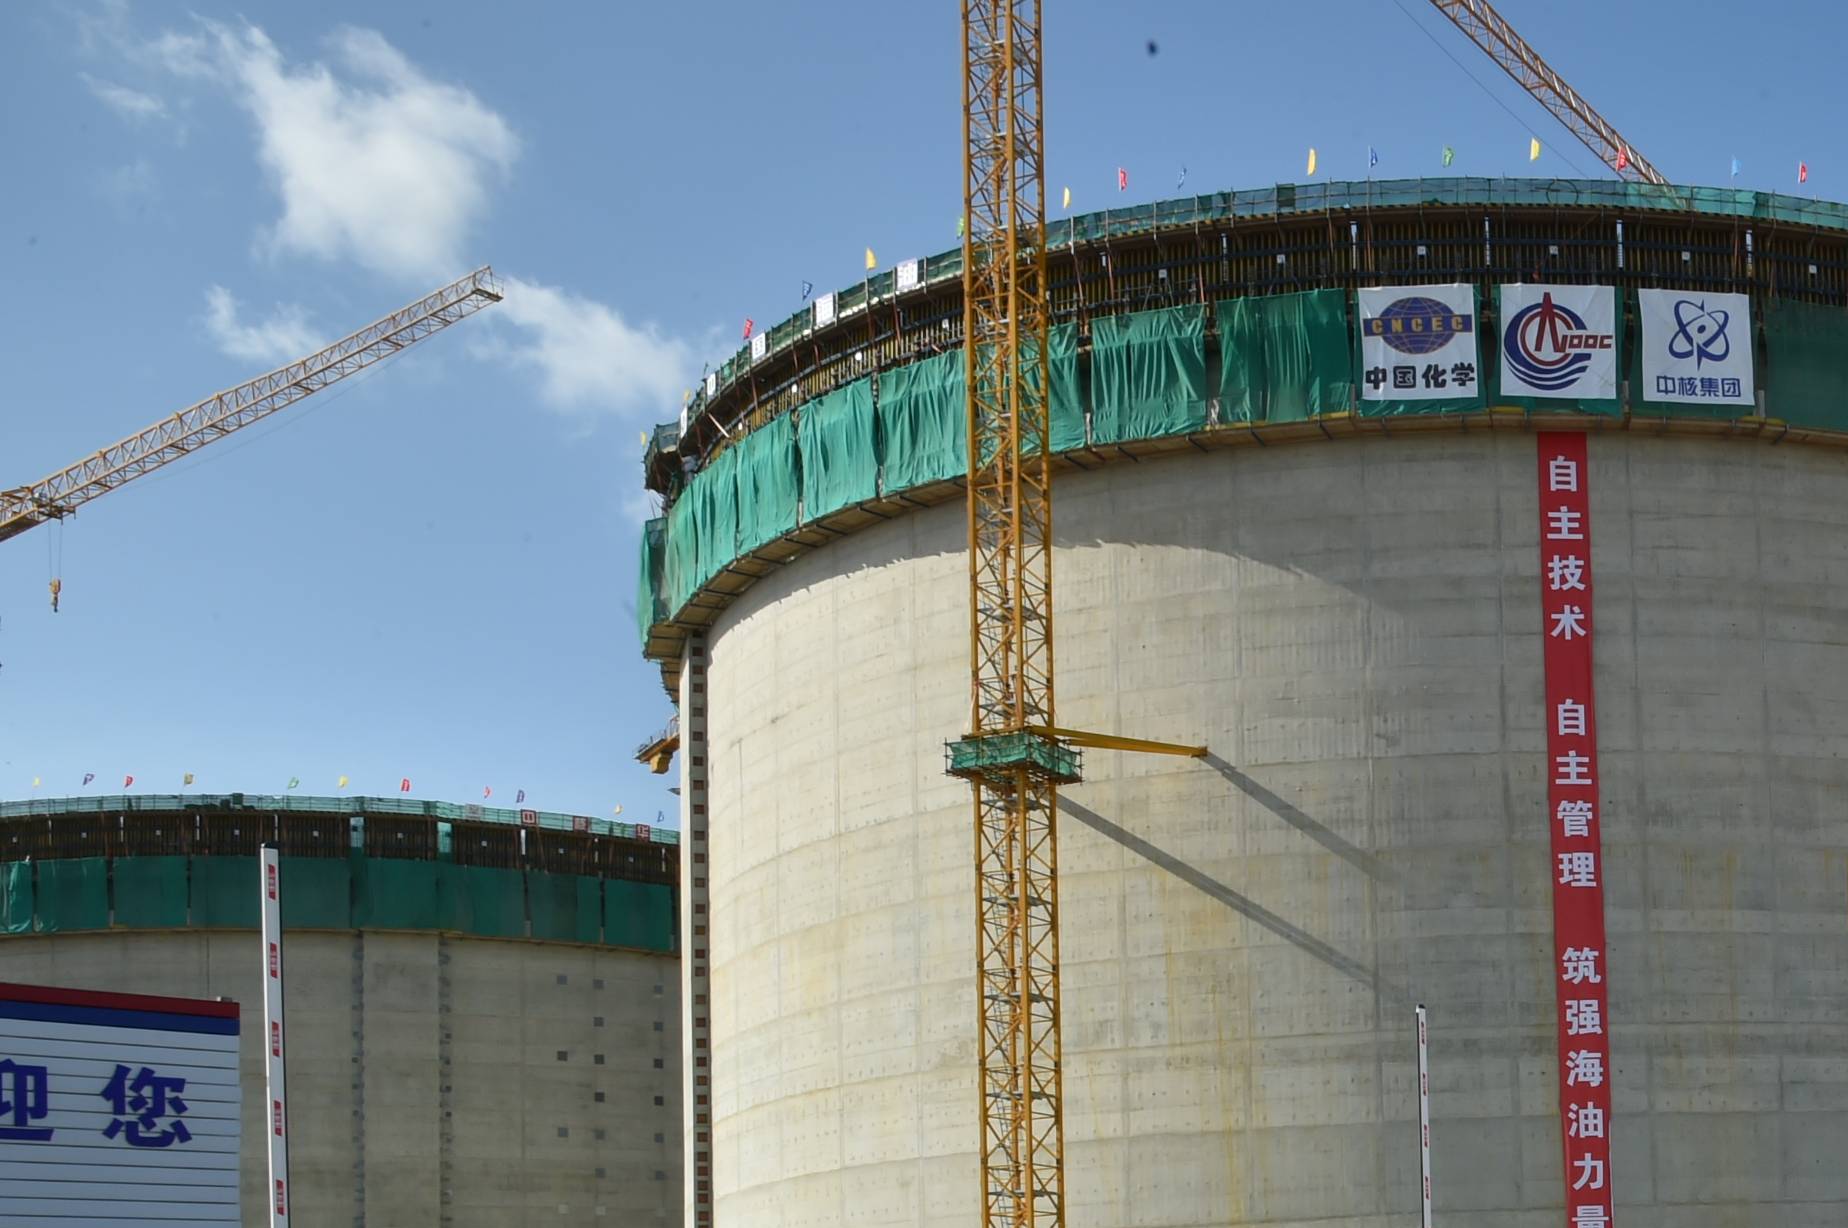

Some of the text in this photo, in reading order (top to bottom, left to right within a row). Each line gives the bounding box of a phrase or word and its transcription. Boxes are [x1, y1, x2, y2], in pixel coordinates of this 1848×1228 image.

[1372, 316, 1463, 334] CNCEC
[1365, 361, 1475, 390] 中国化学
[1656, 374, 1742, 398] 中核集团
[1547, 455, 1587, 641] 自主技术
[1554, 698, 1597, 888] 自主管理
